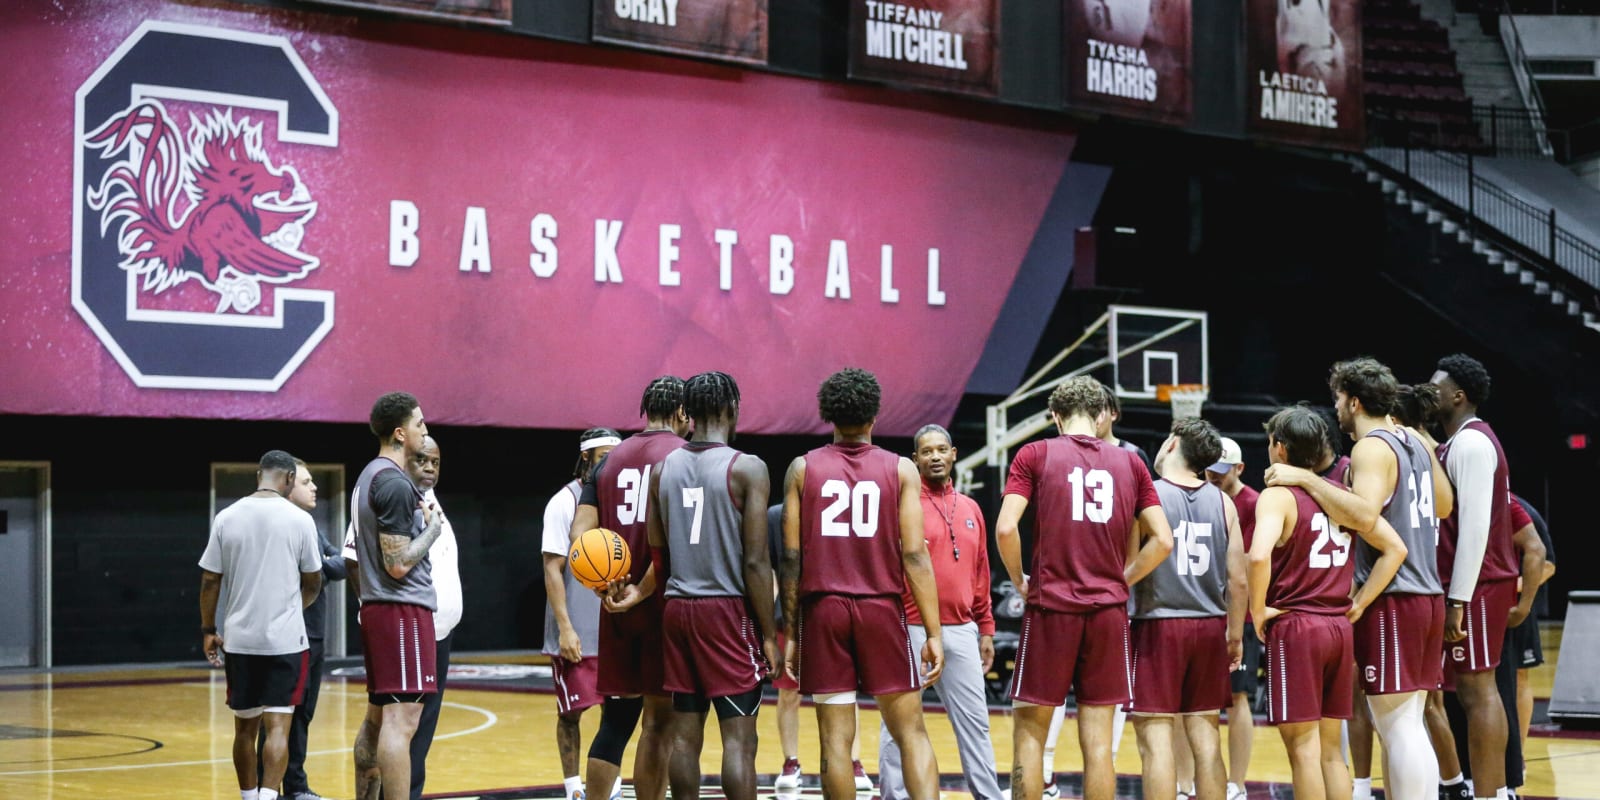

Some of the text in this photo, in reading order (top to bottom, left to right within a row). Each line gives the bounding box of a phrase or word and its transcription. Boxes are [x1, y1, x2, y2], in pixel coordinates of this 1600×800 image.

[865, 0, 943, 29] TIFFANY
[866, 19, 967, 70] MITCHELL
[1087, 38, 1149, 66] TYASHA
[1086, 57, 1157, 102] HARRIS
[1261, 87, 1338, 129] AMIHERE
[389, 199, 948, 307] BASKETBALL
[682, 486, 705, 545] 7
[821, 479, 881, 538] 20
[1067, 466, 1114, 524] 13
[1173, 519, 1212, 577] 15
[1309, 512, 1352, 569] 25
